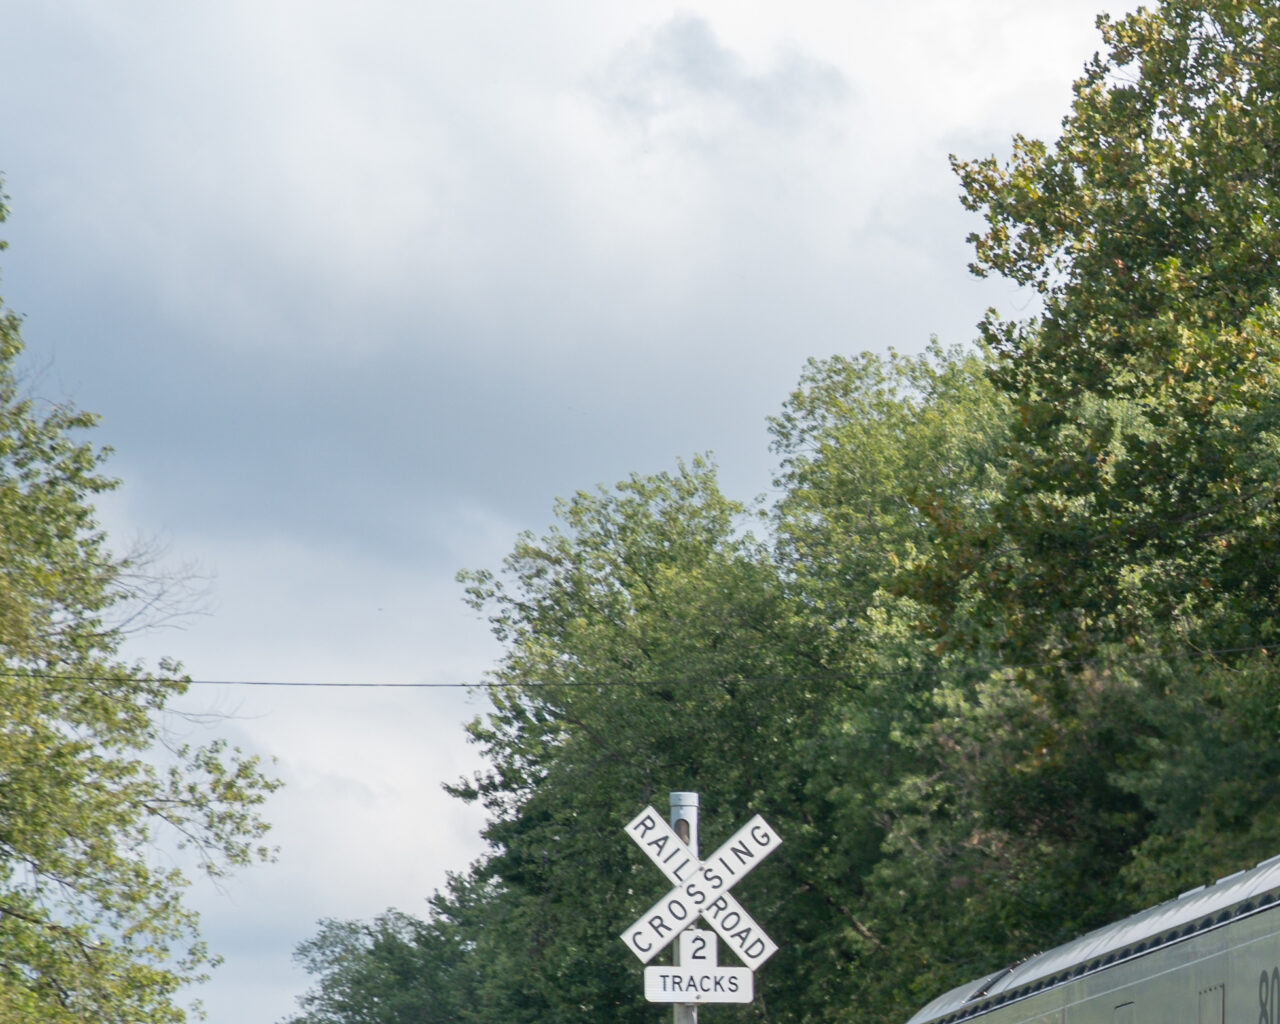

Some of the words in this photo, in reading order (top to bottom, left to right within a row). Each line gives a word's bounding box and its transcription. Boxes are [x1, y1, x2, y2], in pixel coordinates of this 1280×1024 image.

[632, 826, 770, 952] CROSSING
[691, 937, 706, 959] 2
[659, 975, 739, 992] TRACKS
